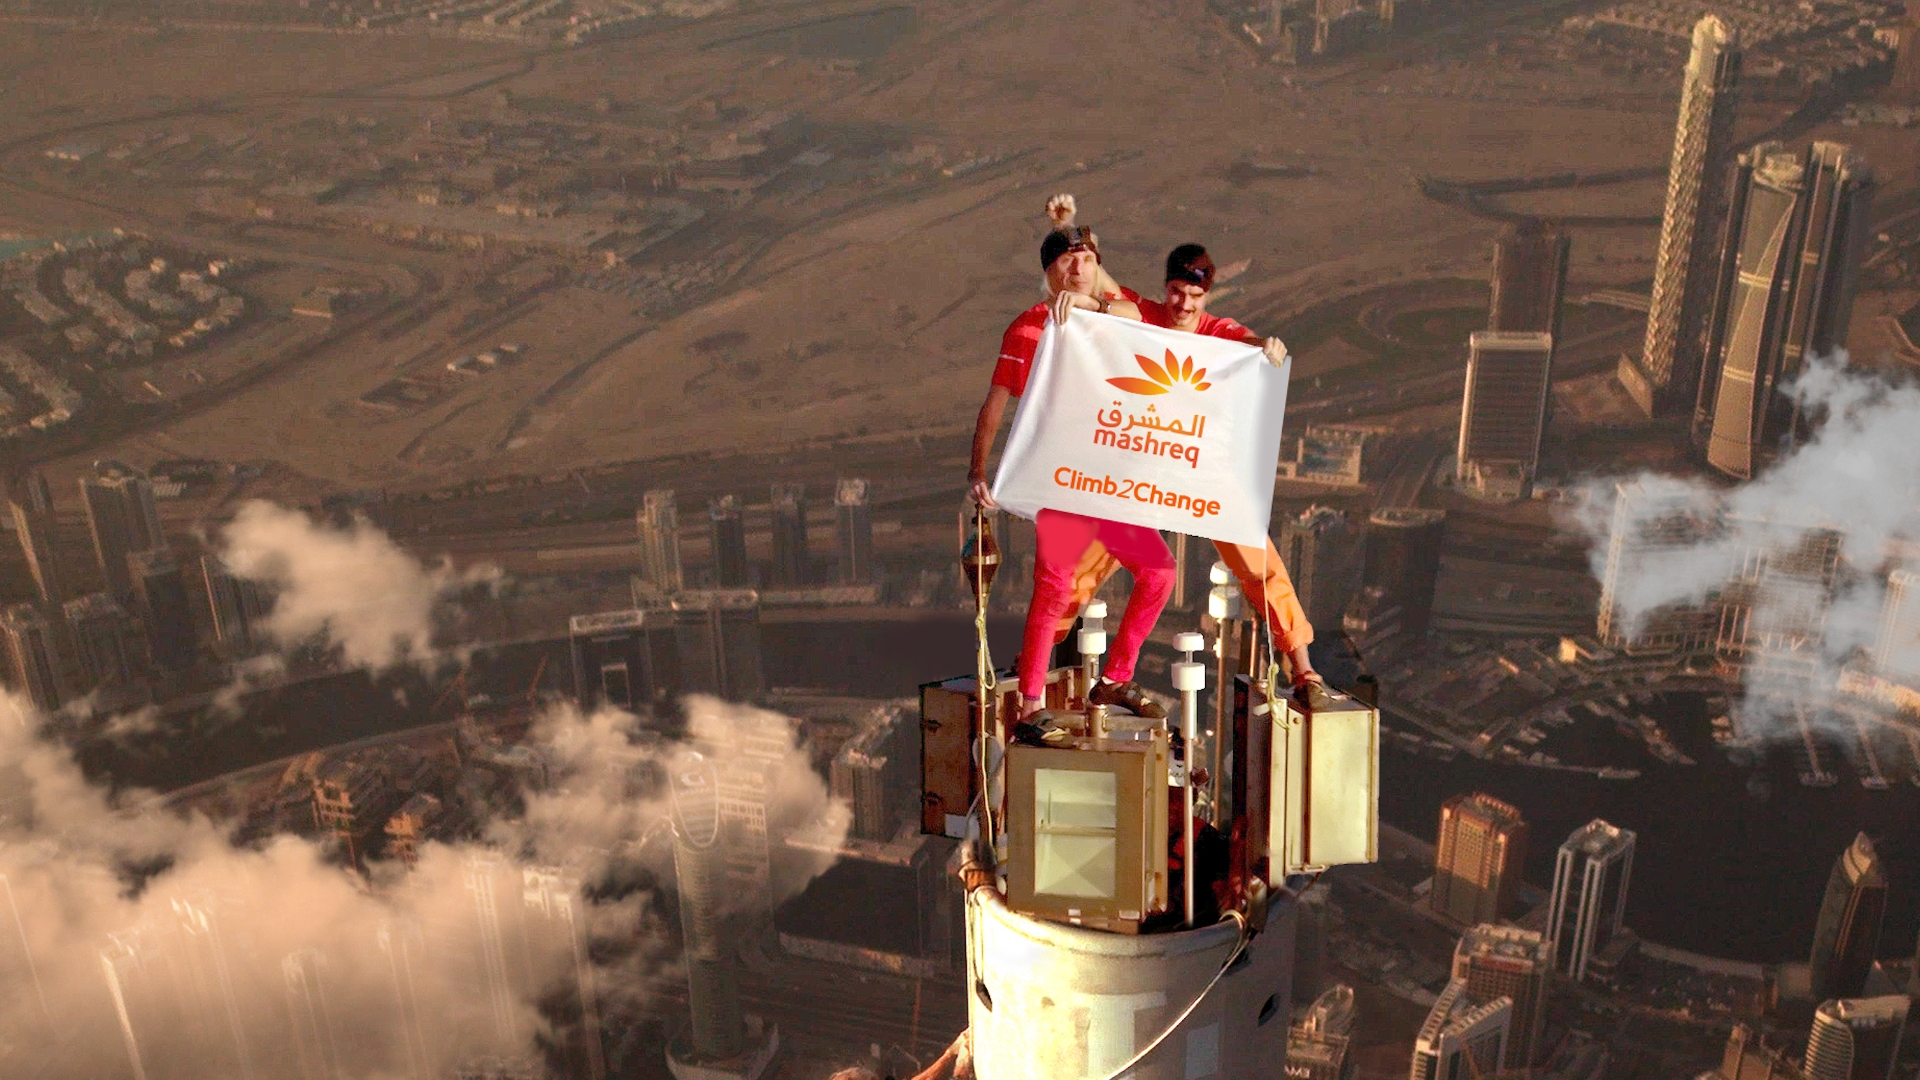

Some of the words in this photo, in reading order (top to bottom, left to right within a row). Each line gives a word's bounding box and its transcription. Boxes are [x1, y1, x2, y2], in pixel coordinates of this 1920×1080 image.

[1097, 400, 1206, 438] المشرق
[1093, 428, 1200, 469] mashreq
[1053, 466, 1221, 518] Climb2Change
